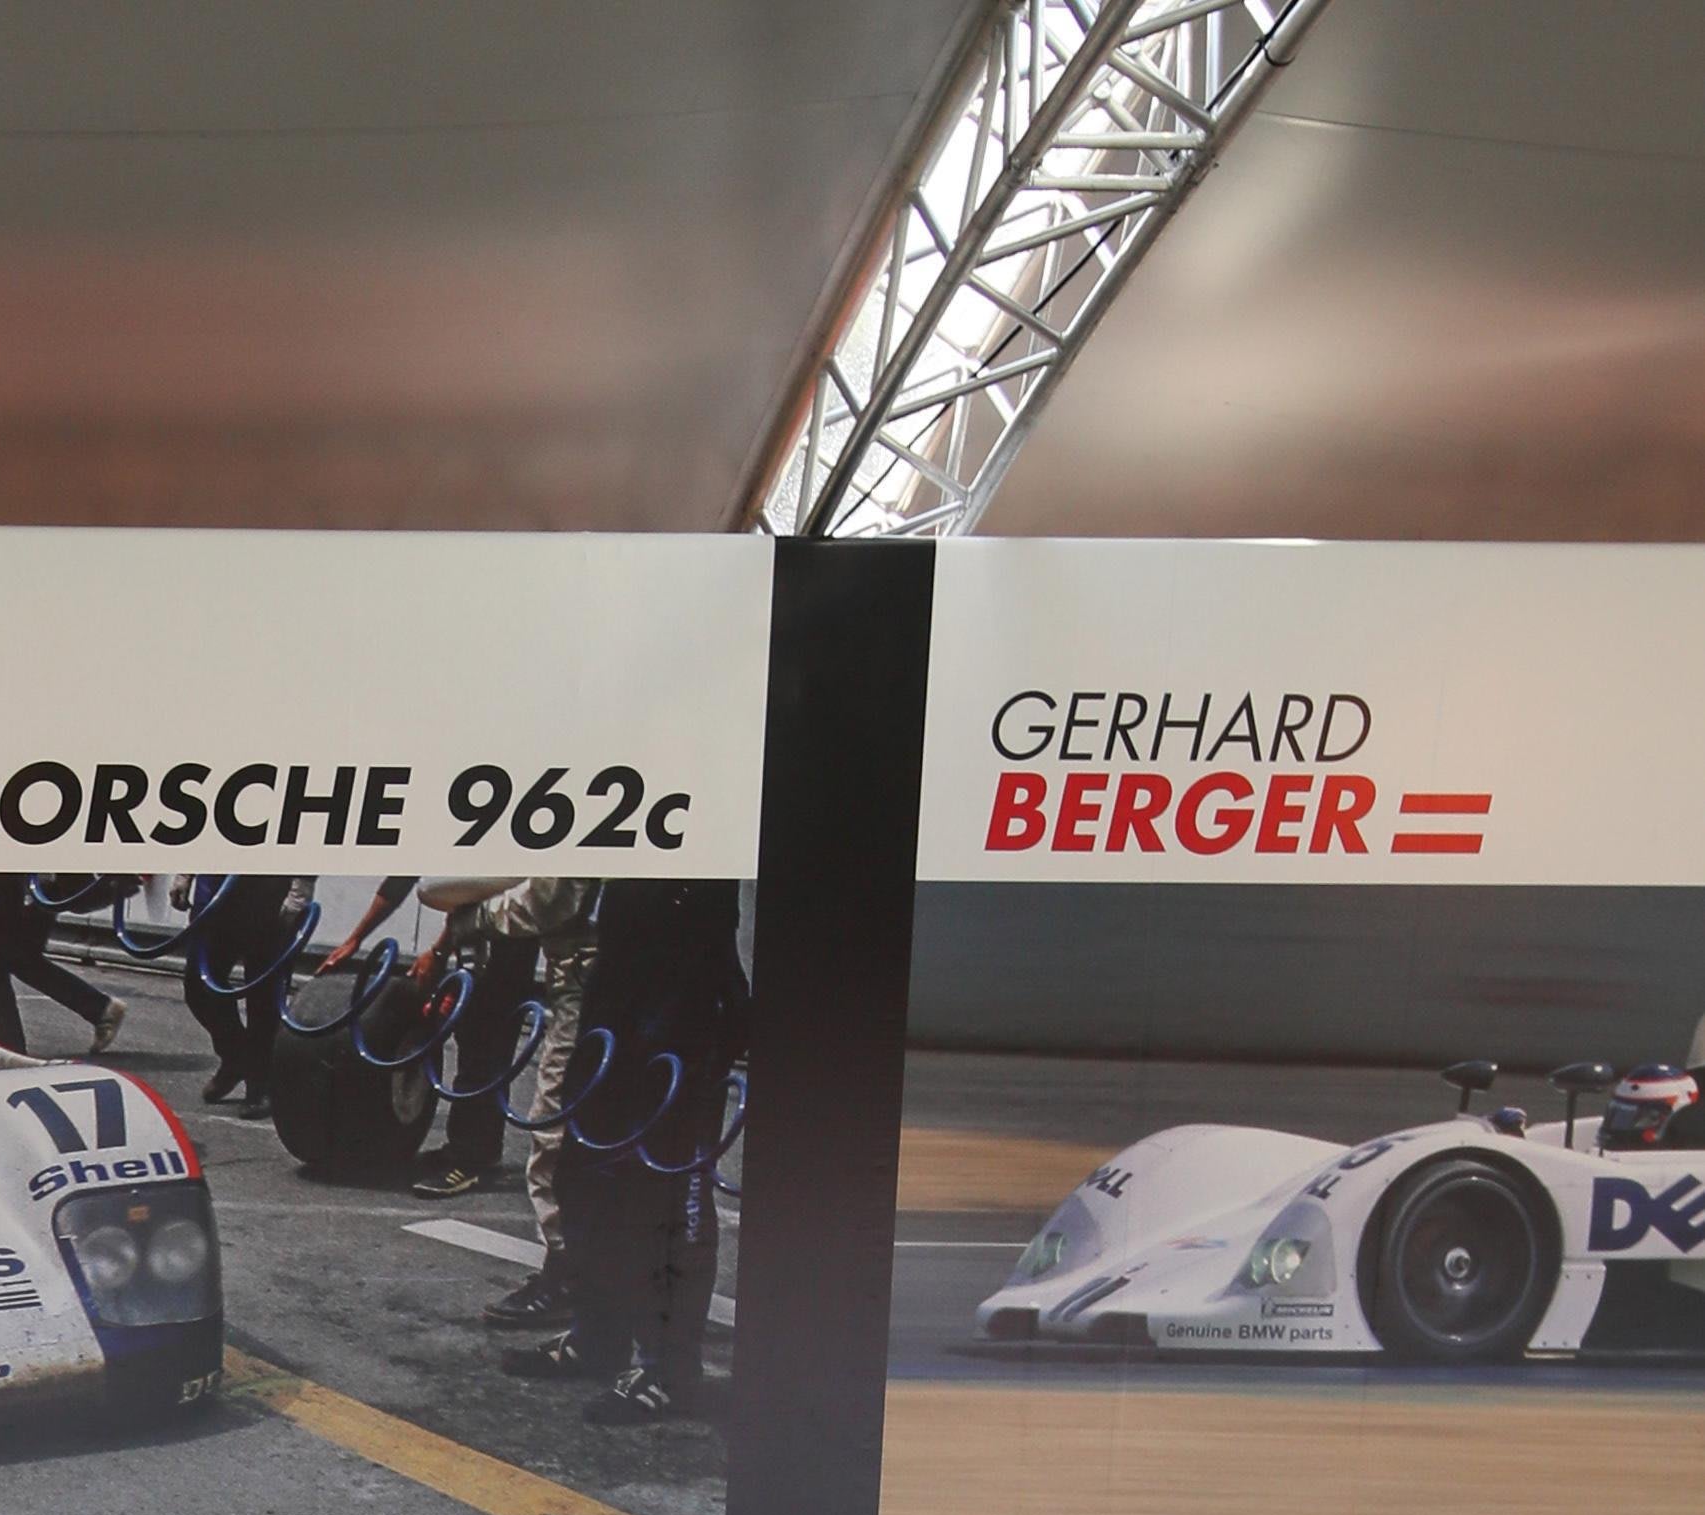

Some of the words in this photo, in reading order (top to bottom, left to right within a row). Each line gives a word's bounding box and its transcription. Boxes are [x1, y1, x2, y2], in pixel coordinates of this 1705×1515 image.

[991, 690, 1372, 762] GERHARD
[447, 764, 691, 850] 962c
[984, 771, 1376, 856] BERGER
[6, 1078, 127, 1155] 17
[28, 1149, 186, 1201] Shell
[1166, 1322, 1233, 1340] Genuine
[1237, 1324, 1286, 1340] BMW
[1289, 1326, 1334, 1342] parts
